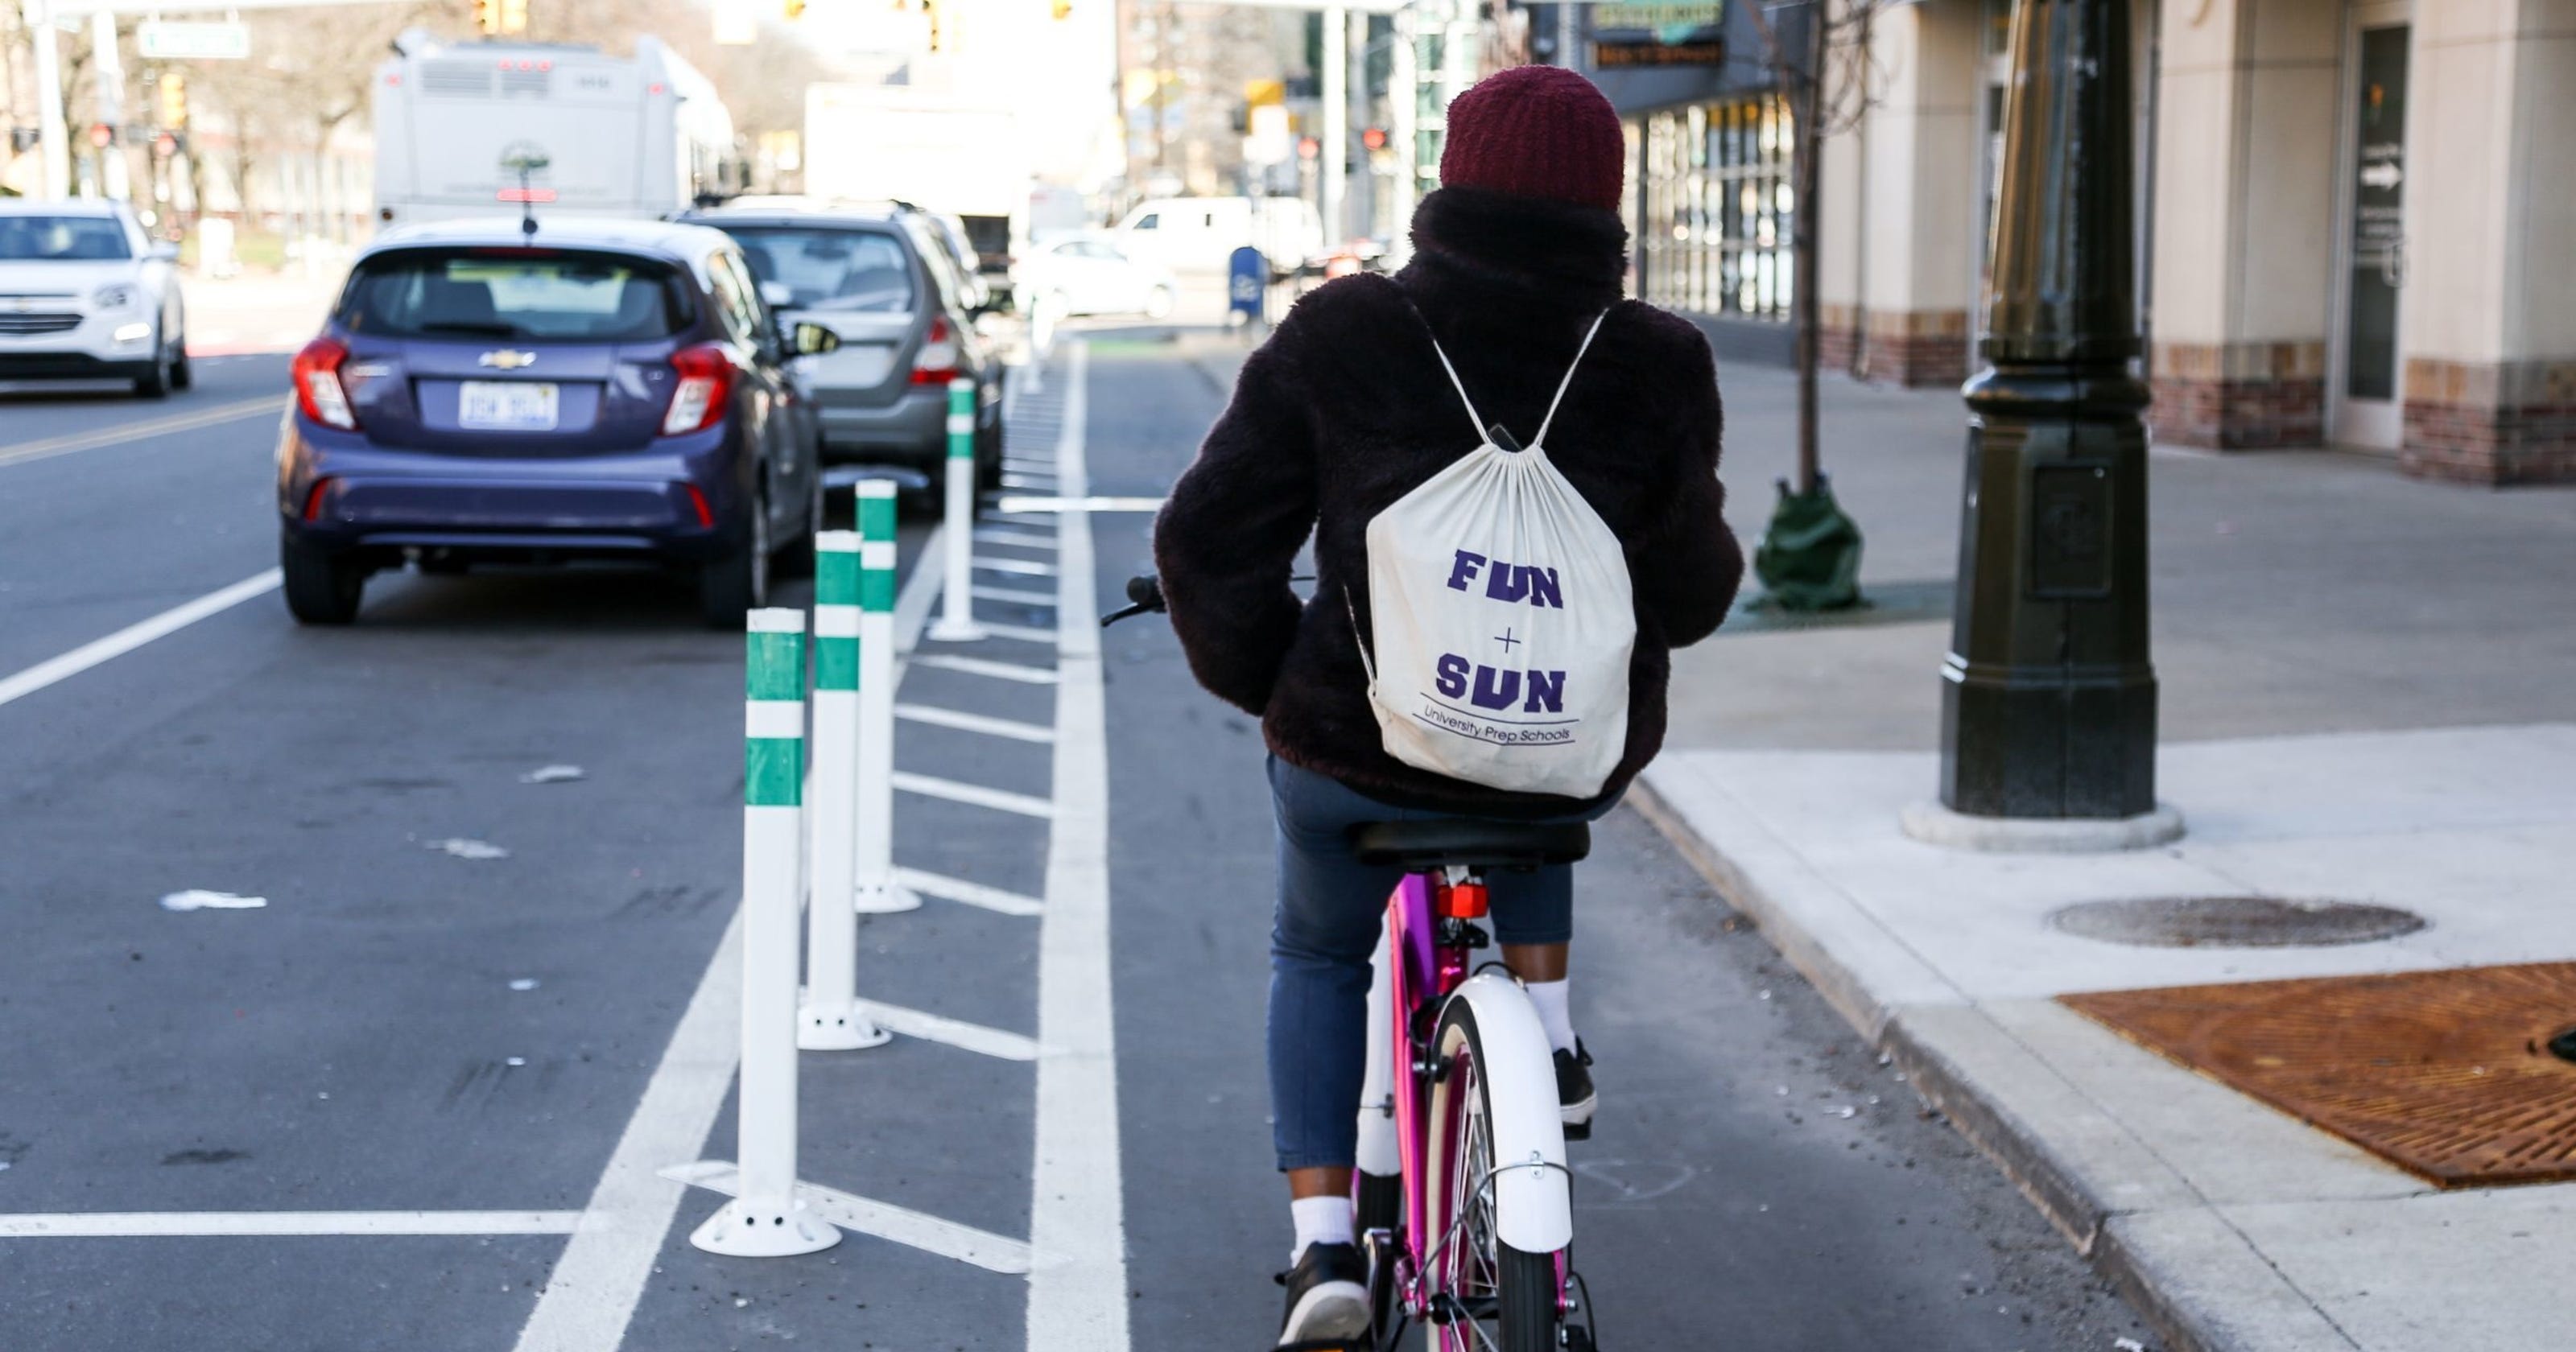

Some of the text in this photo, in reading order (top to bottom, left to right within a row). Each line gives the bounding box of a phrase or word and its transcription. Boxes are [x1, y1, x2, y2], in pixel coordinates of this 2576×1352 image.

[1447, 549, 1563, 609] FUN
[1494, 627, 1521, 653] +
[1436, 653, 1566, 713] SUN
[1425, 705, 1570, 744] University Prep Schools
